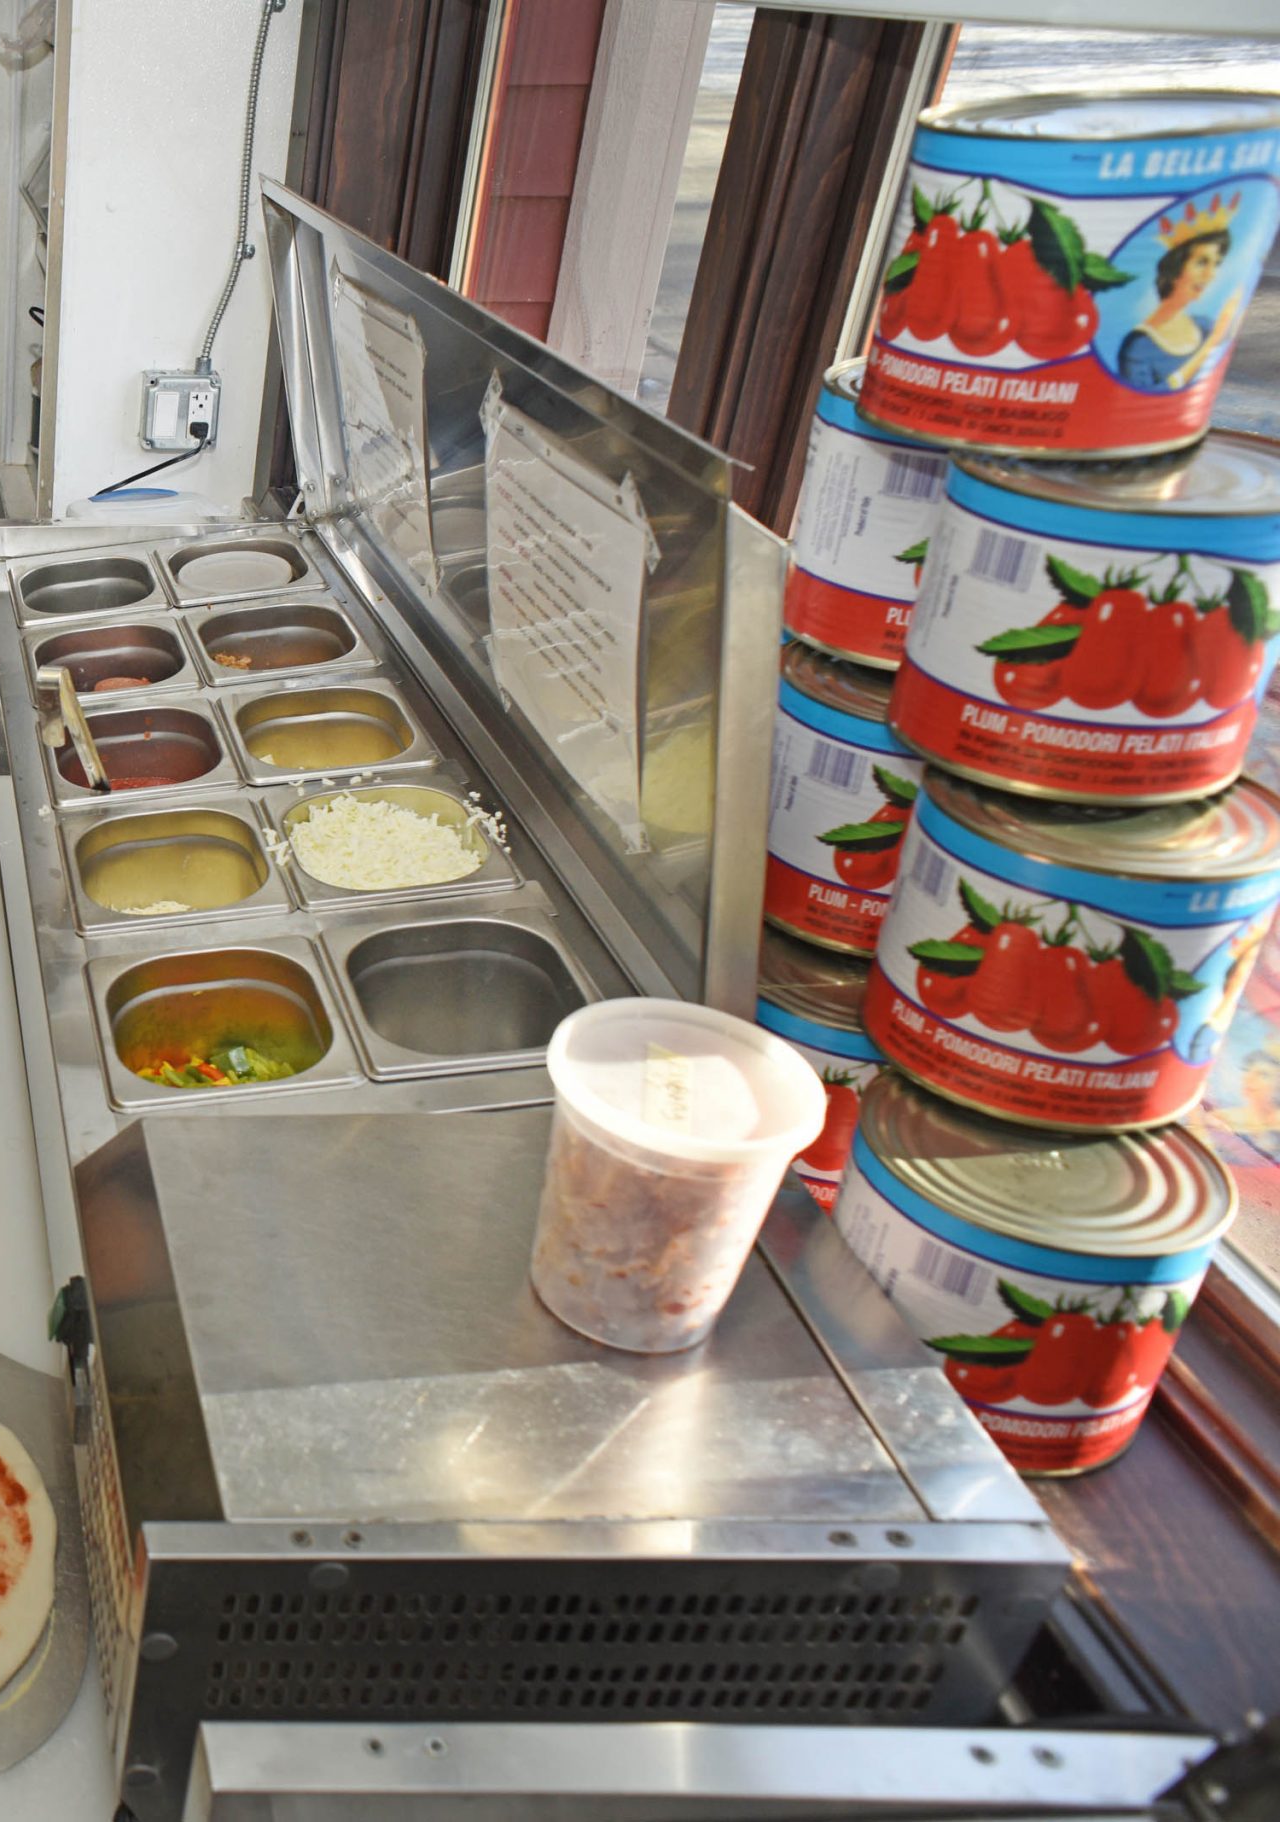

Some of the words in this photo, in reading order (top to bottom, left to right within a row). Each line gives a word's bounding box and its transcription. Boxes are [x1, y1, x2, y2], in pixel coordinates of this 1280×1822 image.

[1099, 152, 1135, 180] LA
[879, 353, 942, 390] POMODORI
[941, 371, 998, 399] PELATI
[999, 377, 1079, 404] ITALIANI
[960, 704, 1009, 734] PLUM
[1021, 721, 1121, 753] POMODORI
[1122, 734, 1184, 755] PELATI
[808, 883, 849, 909] PLUM
[891, 999, 925, 1034] PLUM
[933, 1027, 1023, 1075] POMODORI
[1023, 1060, 1089, 1089] PELATI
